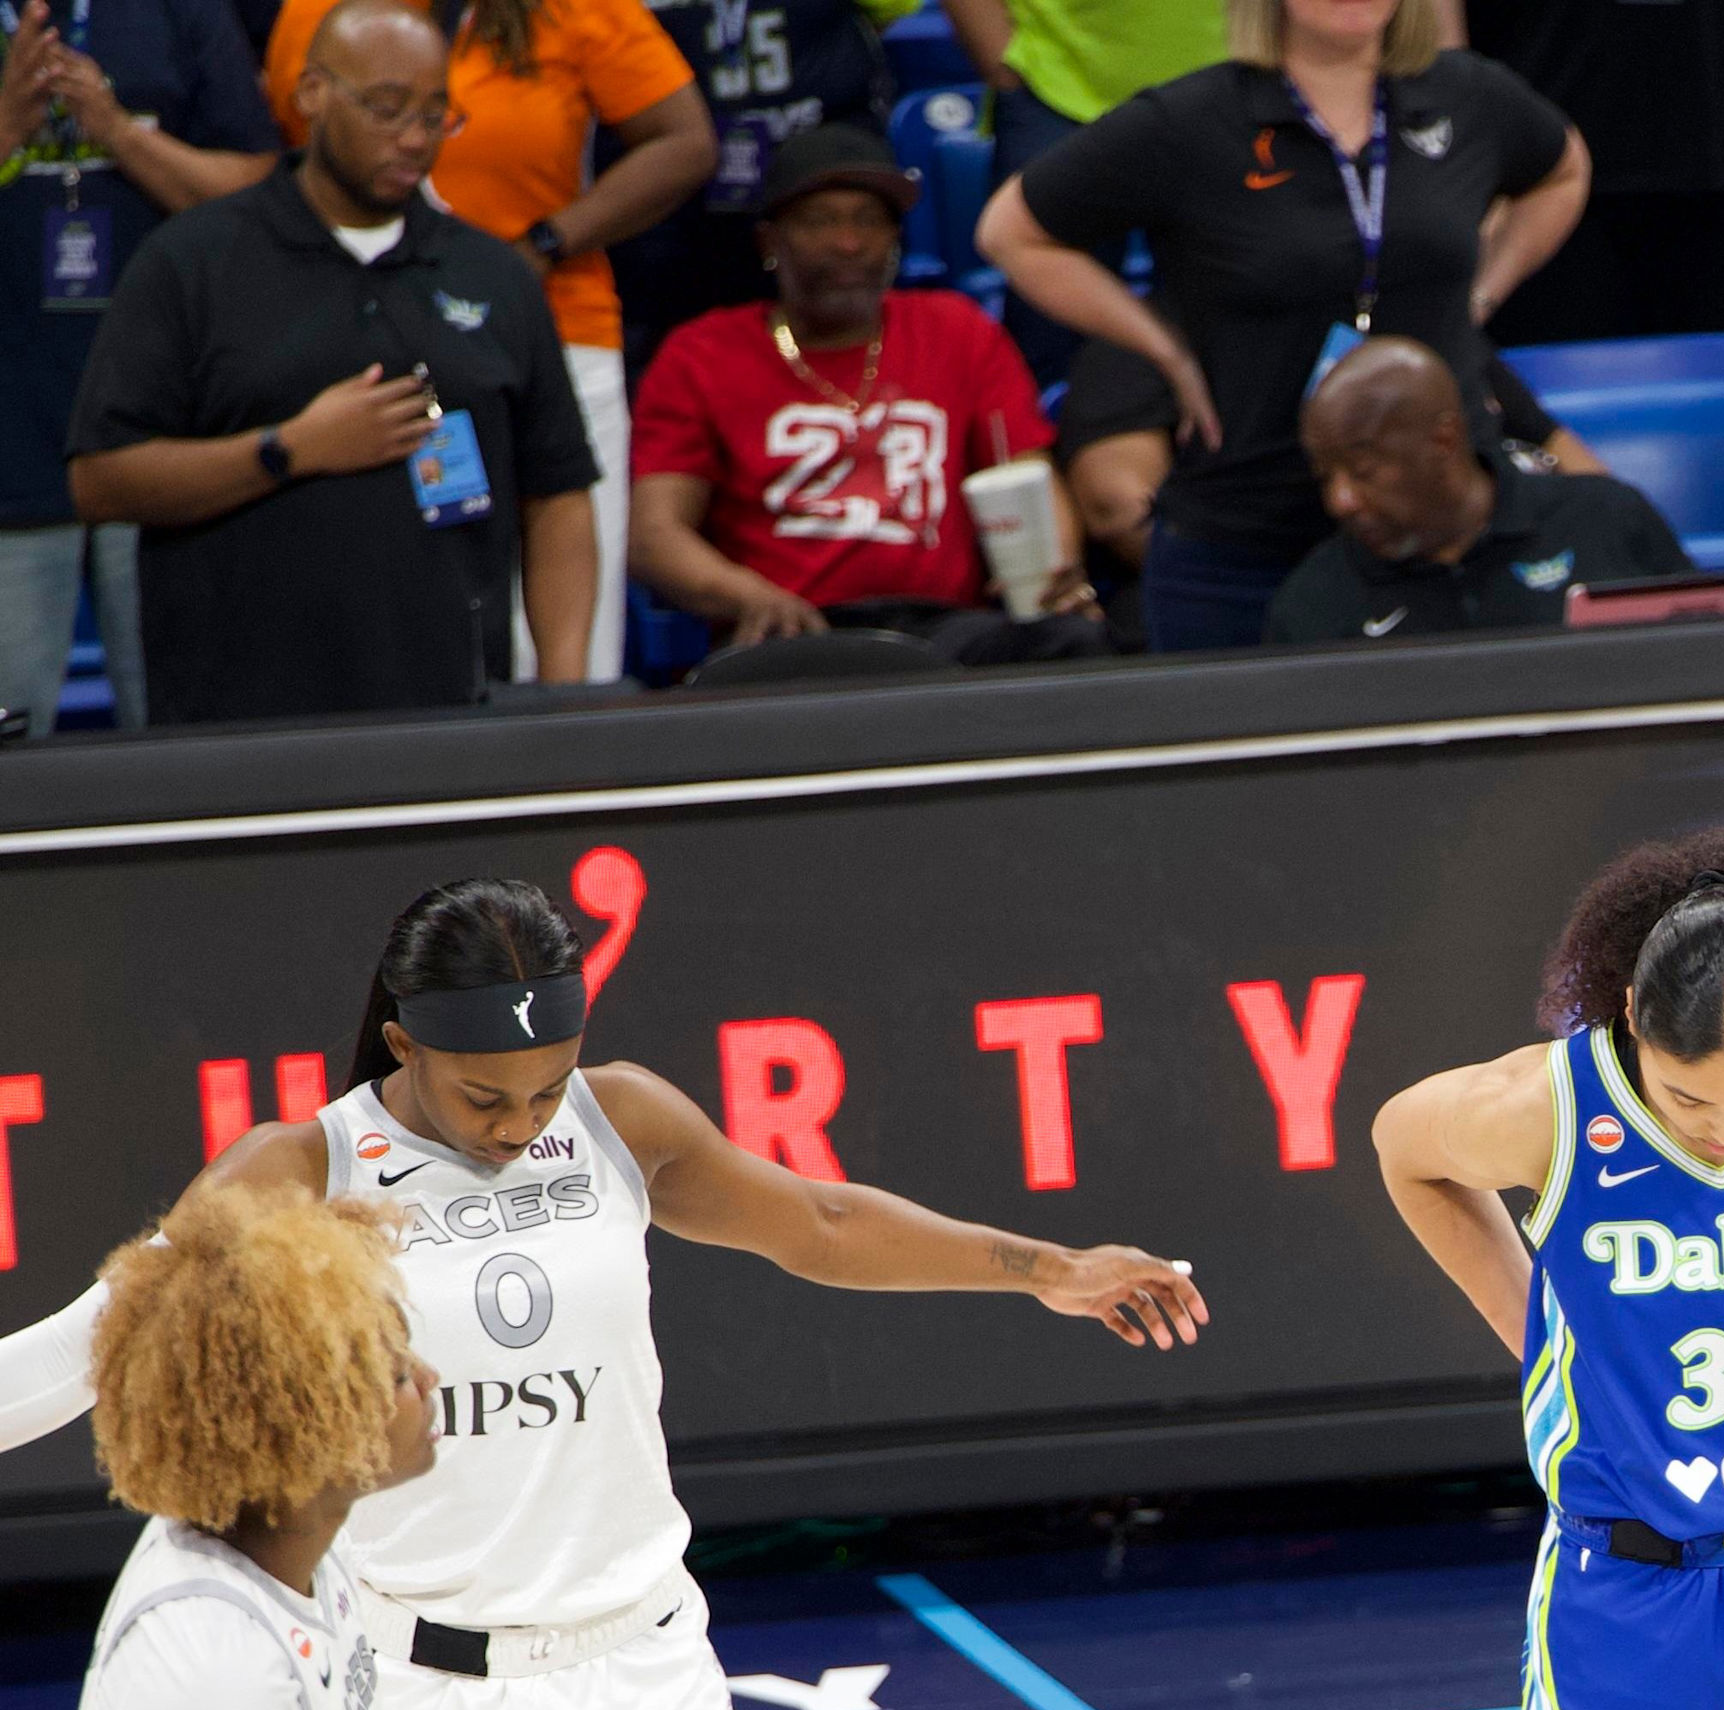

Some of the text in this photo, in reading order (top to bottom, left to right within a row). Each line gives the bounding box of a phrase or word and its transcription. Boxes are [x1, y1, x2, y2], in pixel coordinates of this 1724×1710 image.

[529, 1135, 575, 1160] ally
[396, 1174, 599, 1252] ACES
[475, 1252, 554, 1349] 0
[440, 1366, 603, 1436] IPSY
